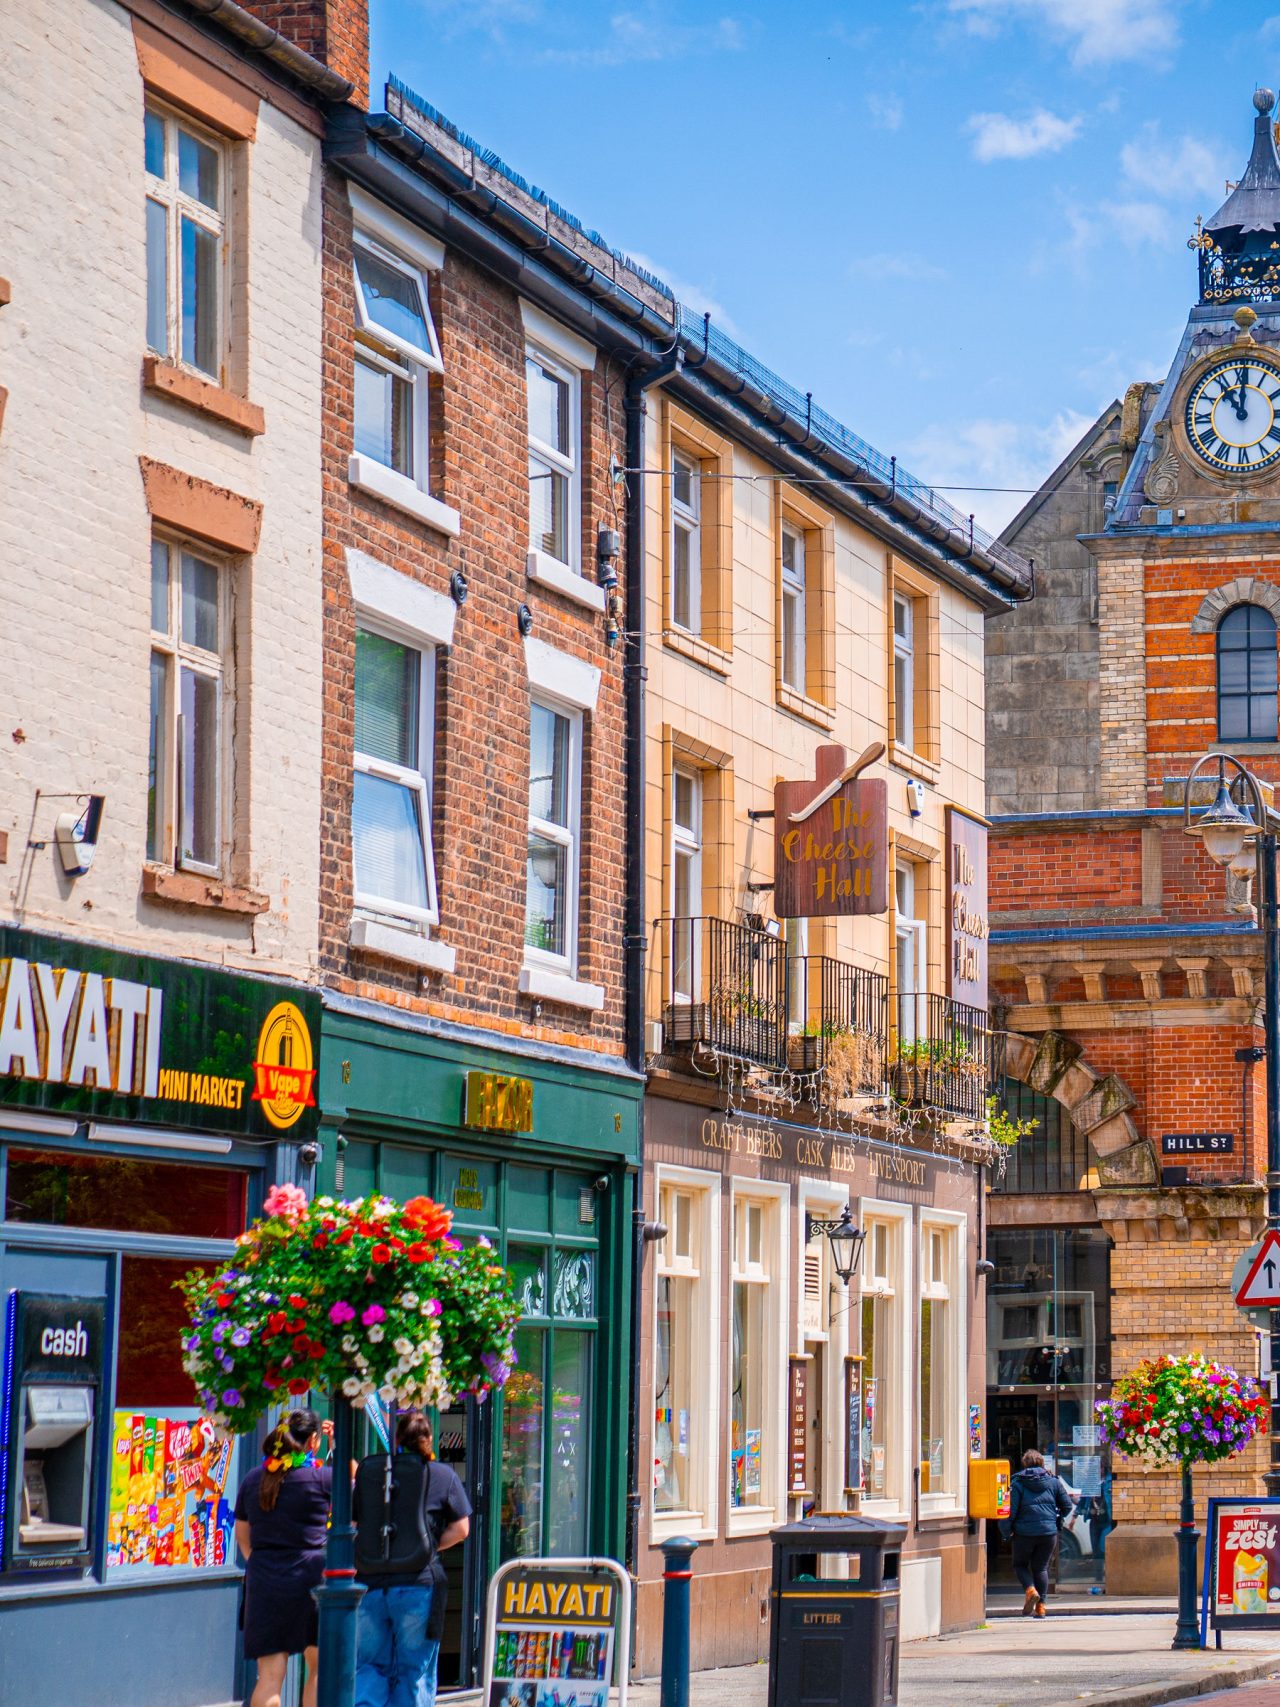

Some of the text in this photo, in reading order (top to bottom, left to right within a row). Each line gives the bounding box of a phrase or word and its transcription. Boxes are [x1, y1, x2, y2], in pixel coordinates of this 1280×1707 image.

[831, 798, 874, 832] The
[781, 829, 876, 863] Cheese
[953, 843, 975, 886] The
[811, 863, 873, 903] Hall
[0, 956, 162, 1099] AYATI
[158, 1068, 245, 1110] MINI MARKET
[269, 1070, 300, 1098] Vape
[702, 1118, 927, 1186] CRAFT BEERS CASK ALES LIVE SPORT
[1168, 1137, 1205, 1149] HILL
[41, 1320, 88, 1357] cash
[1225, 1524, 1278, 1550] zest
[1233, 1519, 1269, 1531] SIMPLY THE
[504, 1581, 613, 1617] HAYATI
[803, 1613, 842, 1624] LITTER
